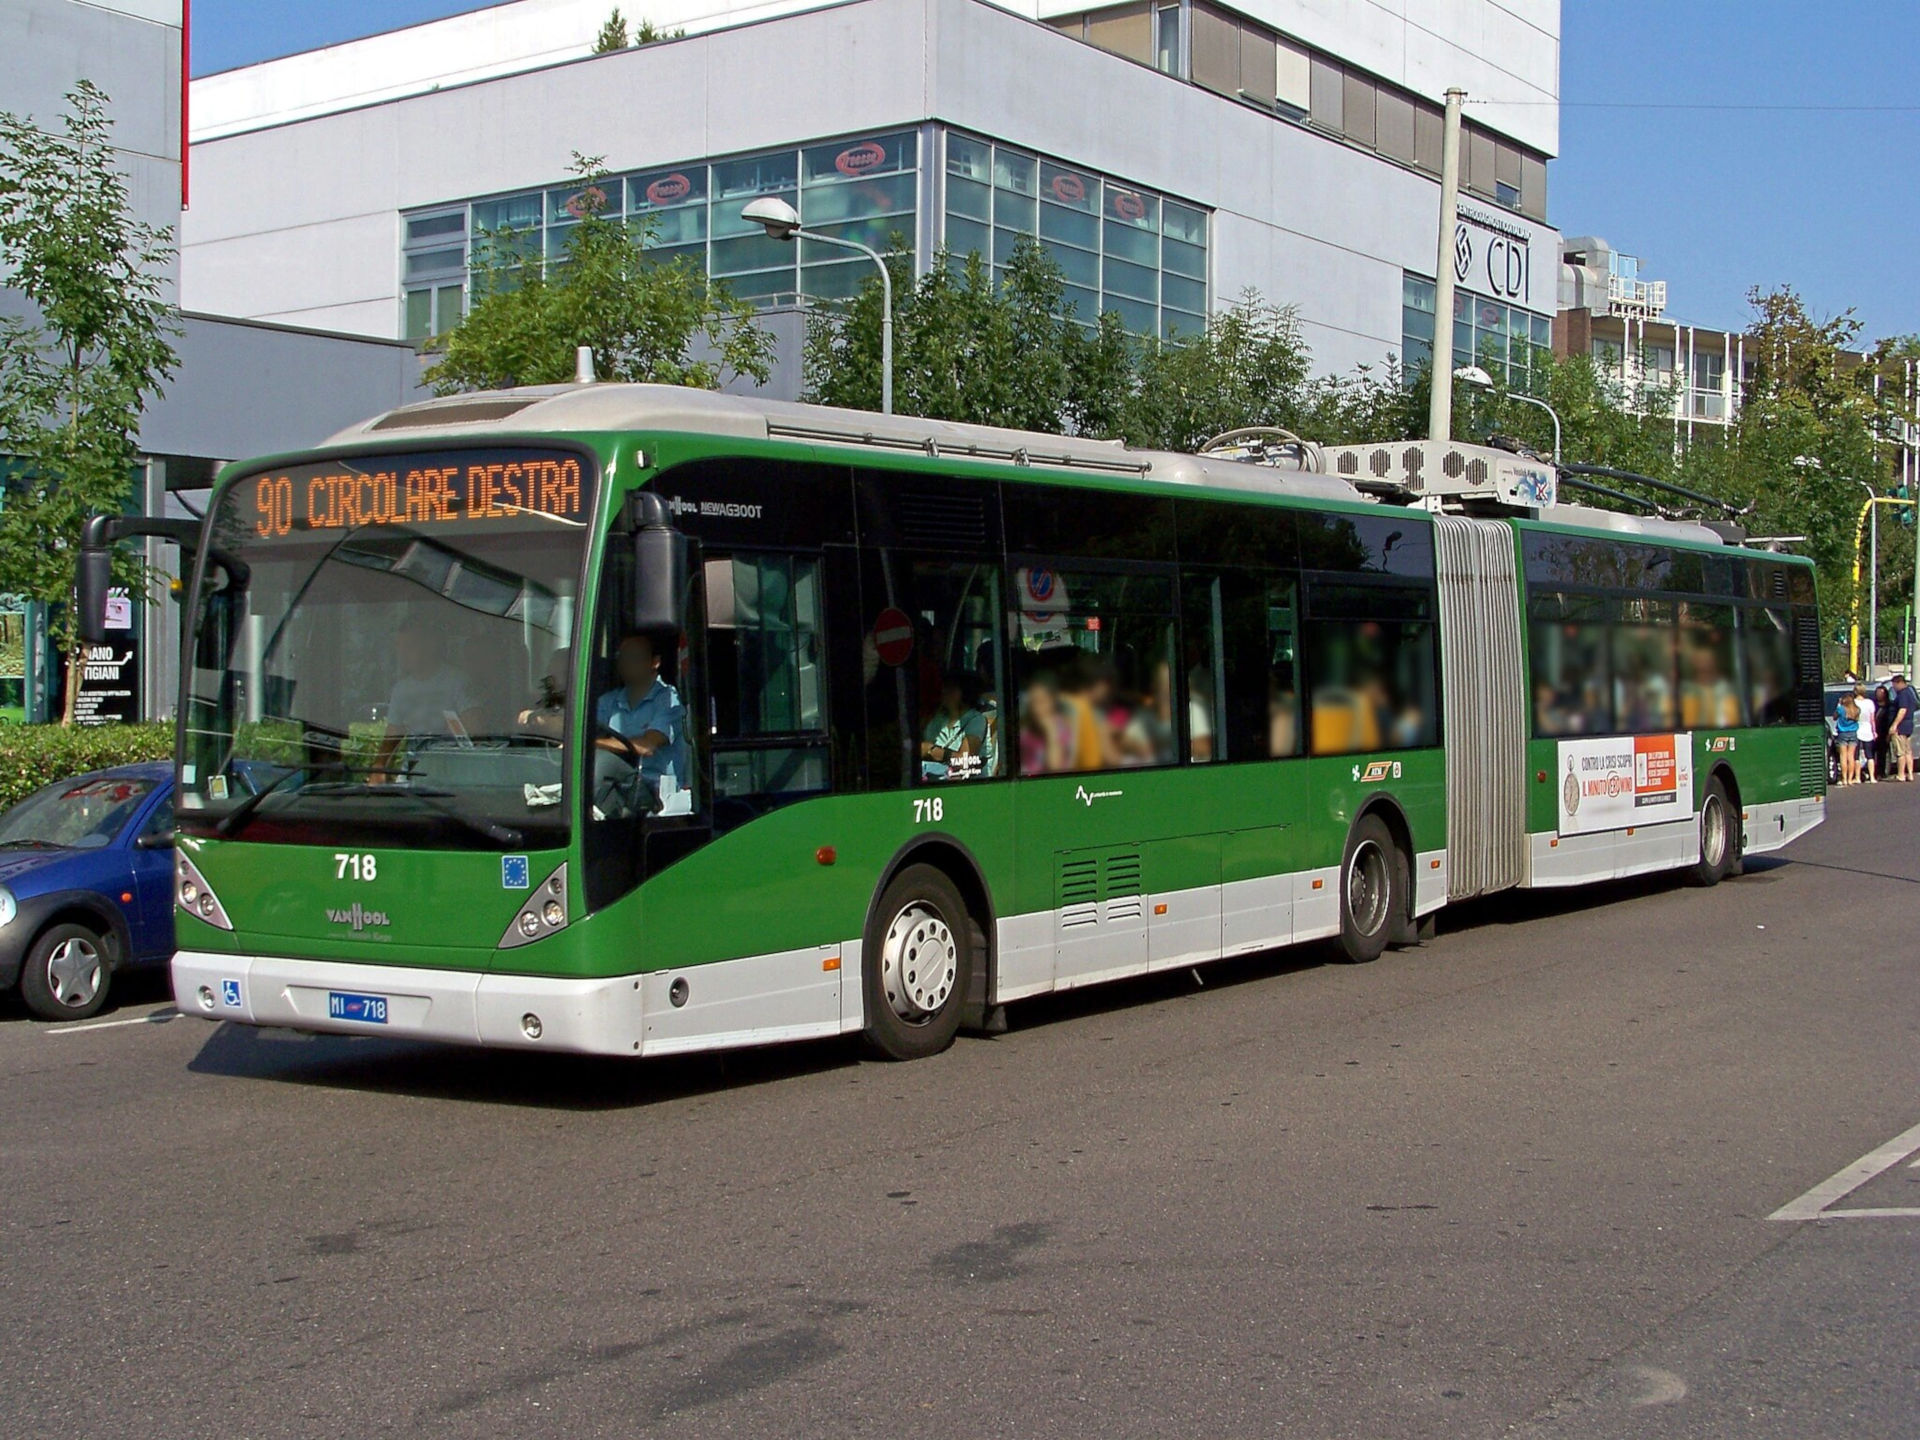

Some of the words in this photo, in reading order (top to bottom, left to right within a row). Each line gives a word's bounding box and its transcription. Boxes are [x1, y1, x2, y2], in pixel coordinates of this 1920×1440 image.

[1487, 236, 1530, 304] CDI
[256, 476, 293, 536] 90
[307, 467, 459, 528] CIRCOLARE
[467, 459, 580, 518] DESTRA
[913, 797, 943, 823] 718
[334, 853, 377, 881] 718
[331, 996, 344, 1015] MI
[363, 1000, 386, 1019] 718
